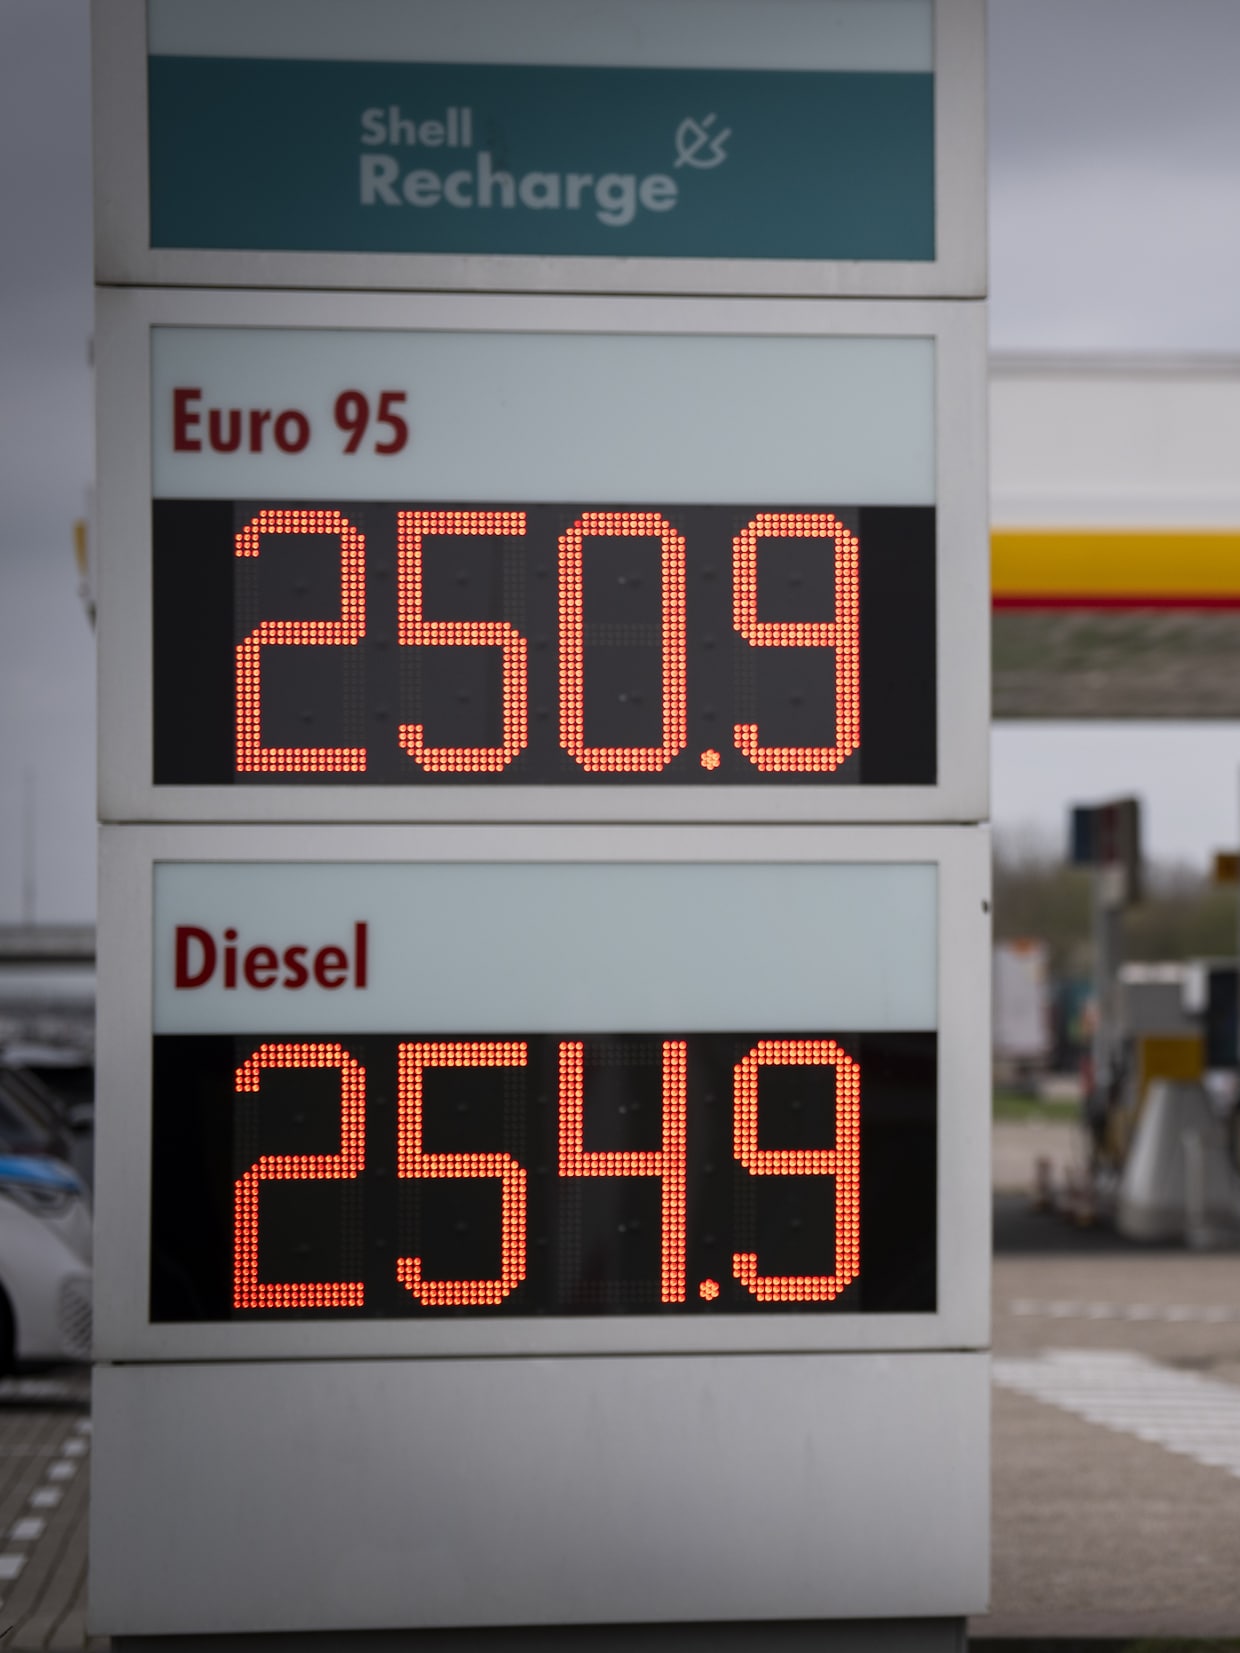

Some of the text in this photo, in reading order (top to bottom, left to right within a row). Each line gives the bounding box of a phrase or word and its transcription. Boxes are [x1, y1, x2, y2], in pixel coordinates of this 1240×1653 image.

[360, 107, 473, 149] Shell
[359, 152, 679, 227] Recharge
[172, 387, 409, 457] Euro 95
[234, 509, 861, 773] 250.9
[174, 921, 369, 990] Diesel
[233, 1039, 861, 1309] 254.9
